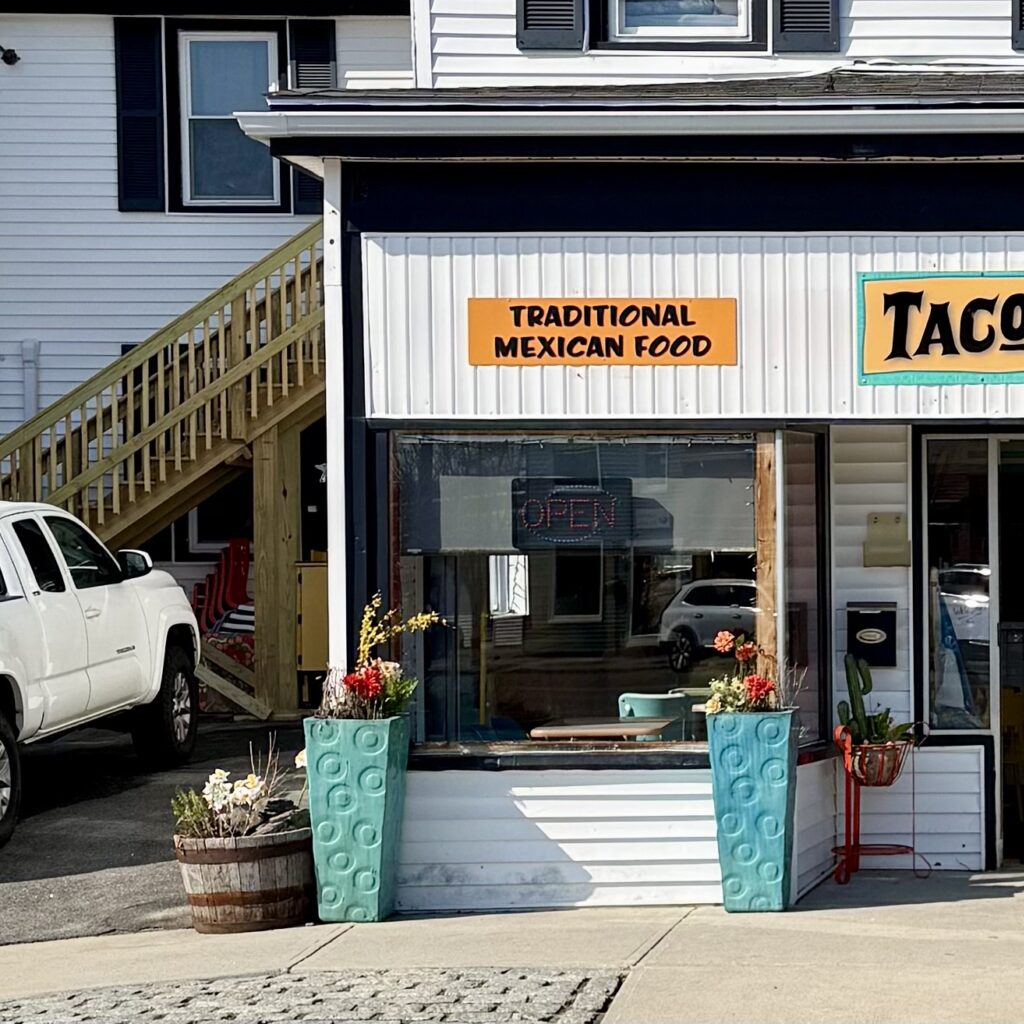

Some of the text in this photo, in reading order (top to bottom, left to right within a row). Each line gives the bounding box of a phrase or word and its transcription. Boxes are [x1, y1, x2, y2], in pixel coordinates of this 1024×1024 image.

[509, 304, 696, 327] TRADITIONAL
[494, 334, 712, 359] MEXICAN FOOD
[520, 498, 617, 528] OPEN
